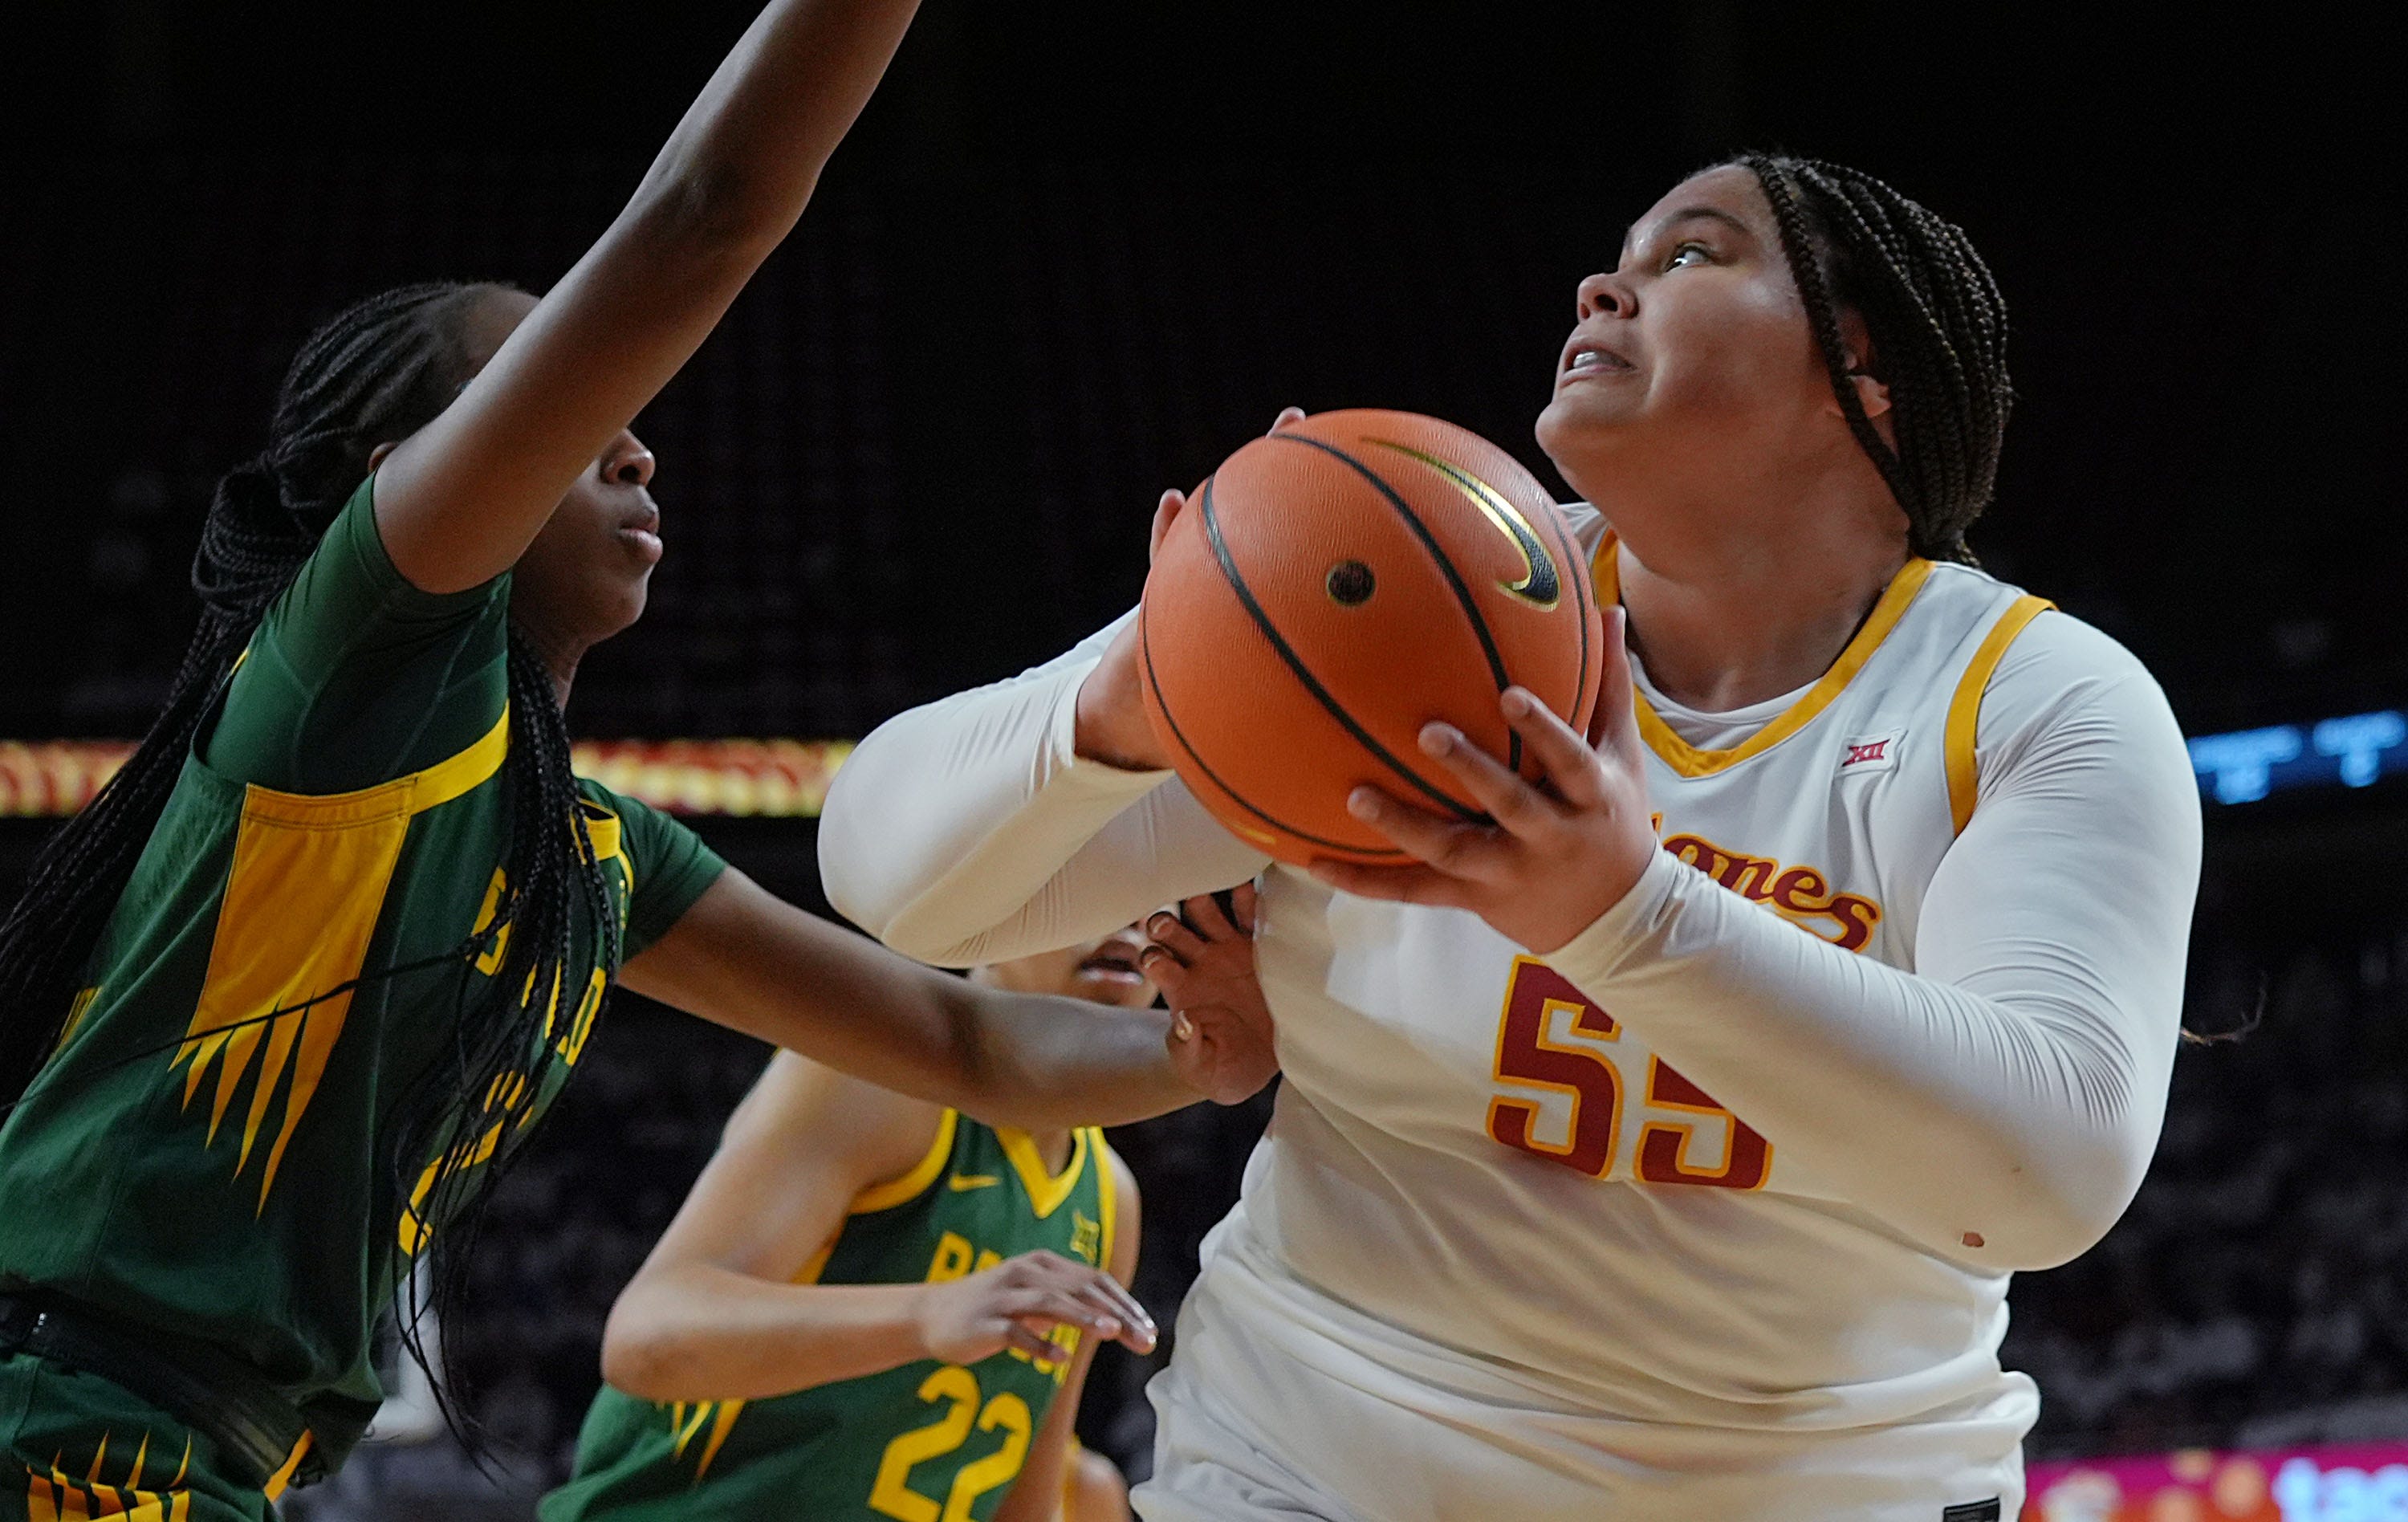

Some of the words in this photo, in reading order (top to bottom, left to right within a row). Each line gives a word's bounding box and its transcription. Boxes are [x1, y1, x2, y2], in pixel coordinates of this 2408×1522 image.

[1841, 738, 1890, 767] XII
[1485, 954, 1774, 1190] 55
[868, 1363, 1032, 1522] 22
